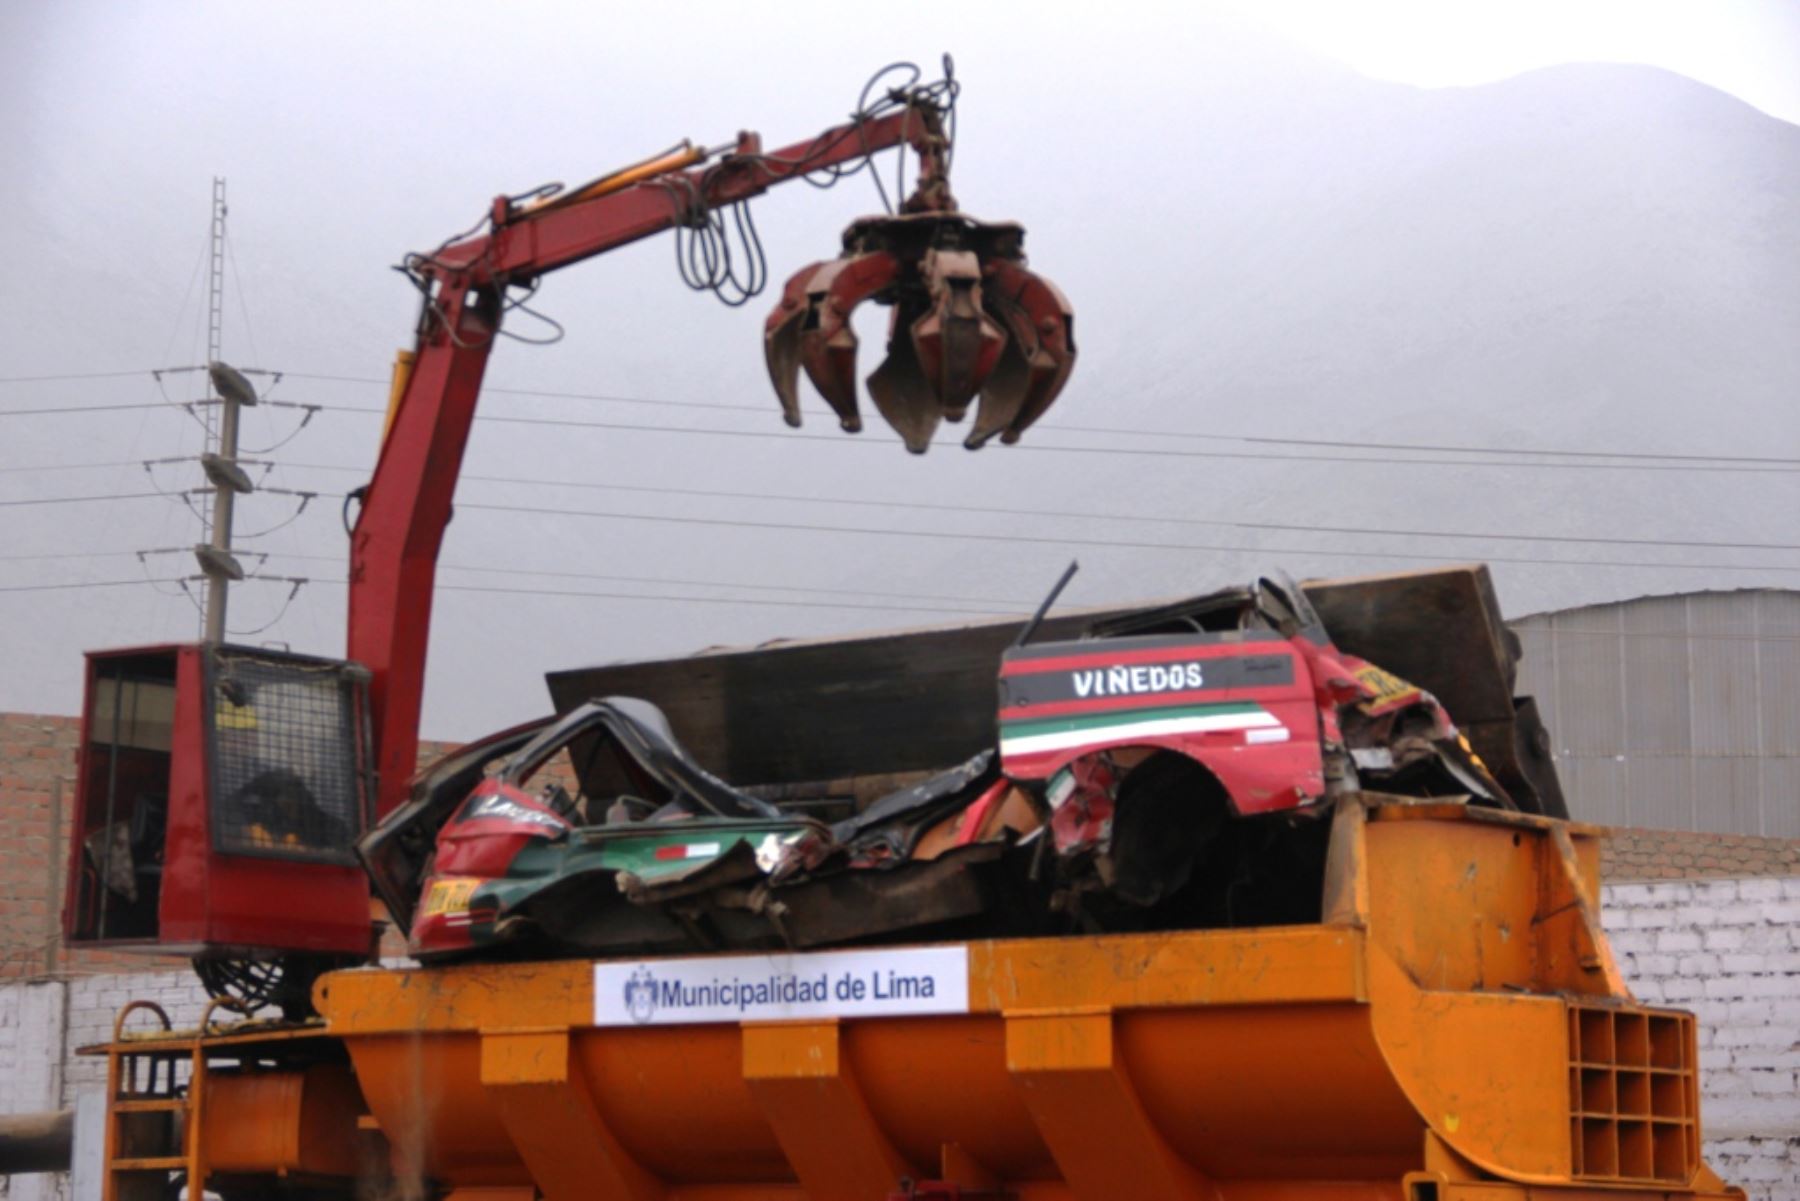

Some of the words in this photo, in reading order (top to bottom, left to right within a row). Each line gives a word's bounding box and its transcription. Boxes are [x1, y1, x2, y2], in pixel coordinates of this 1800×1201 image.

[1072, 662, 1203, 697] VIÑEDOS
[661, 972, 828, 1012] Municipalidad
[835, 971, 866, 1001] de
[873, 970, 935, 999] Lima
